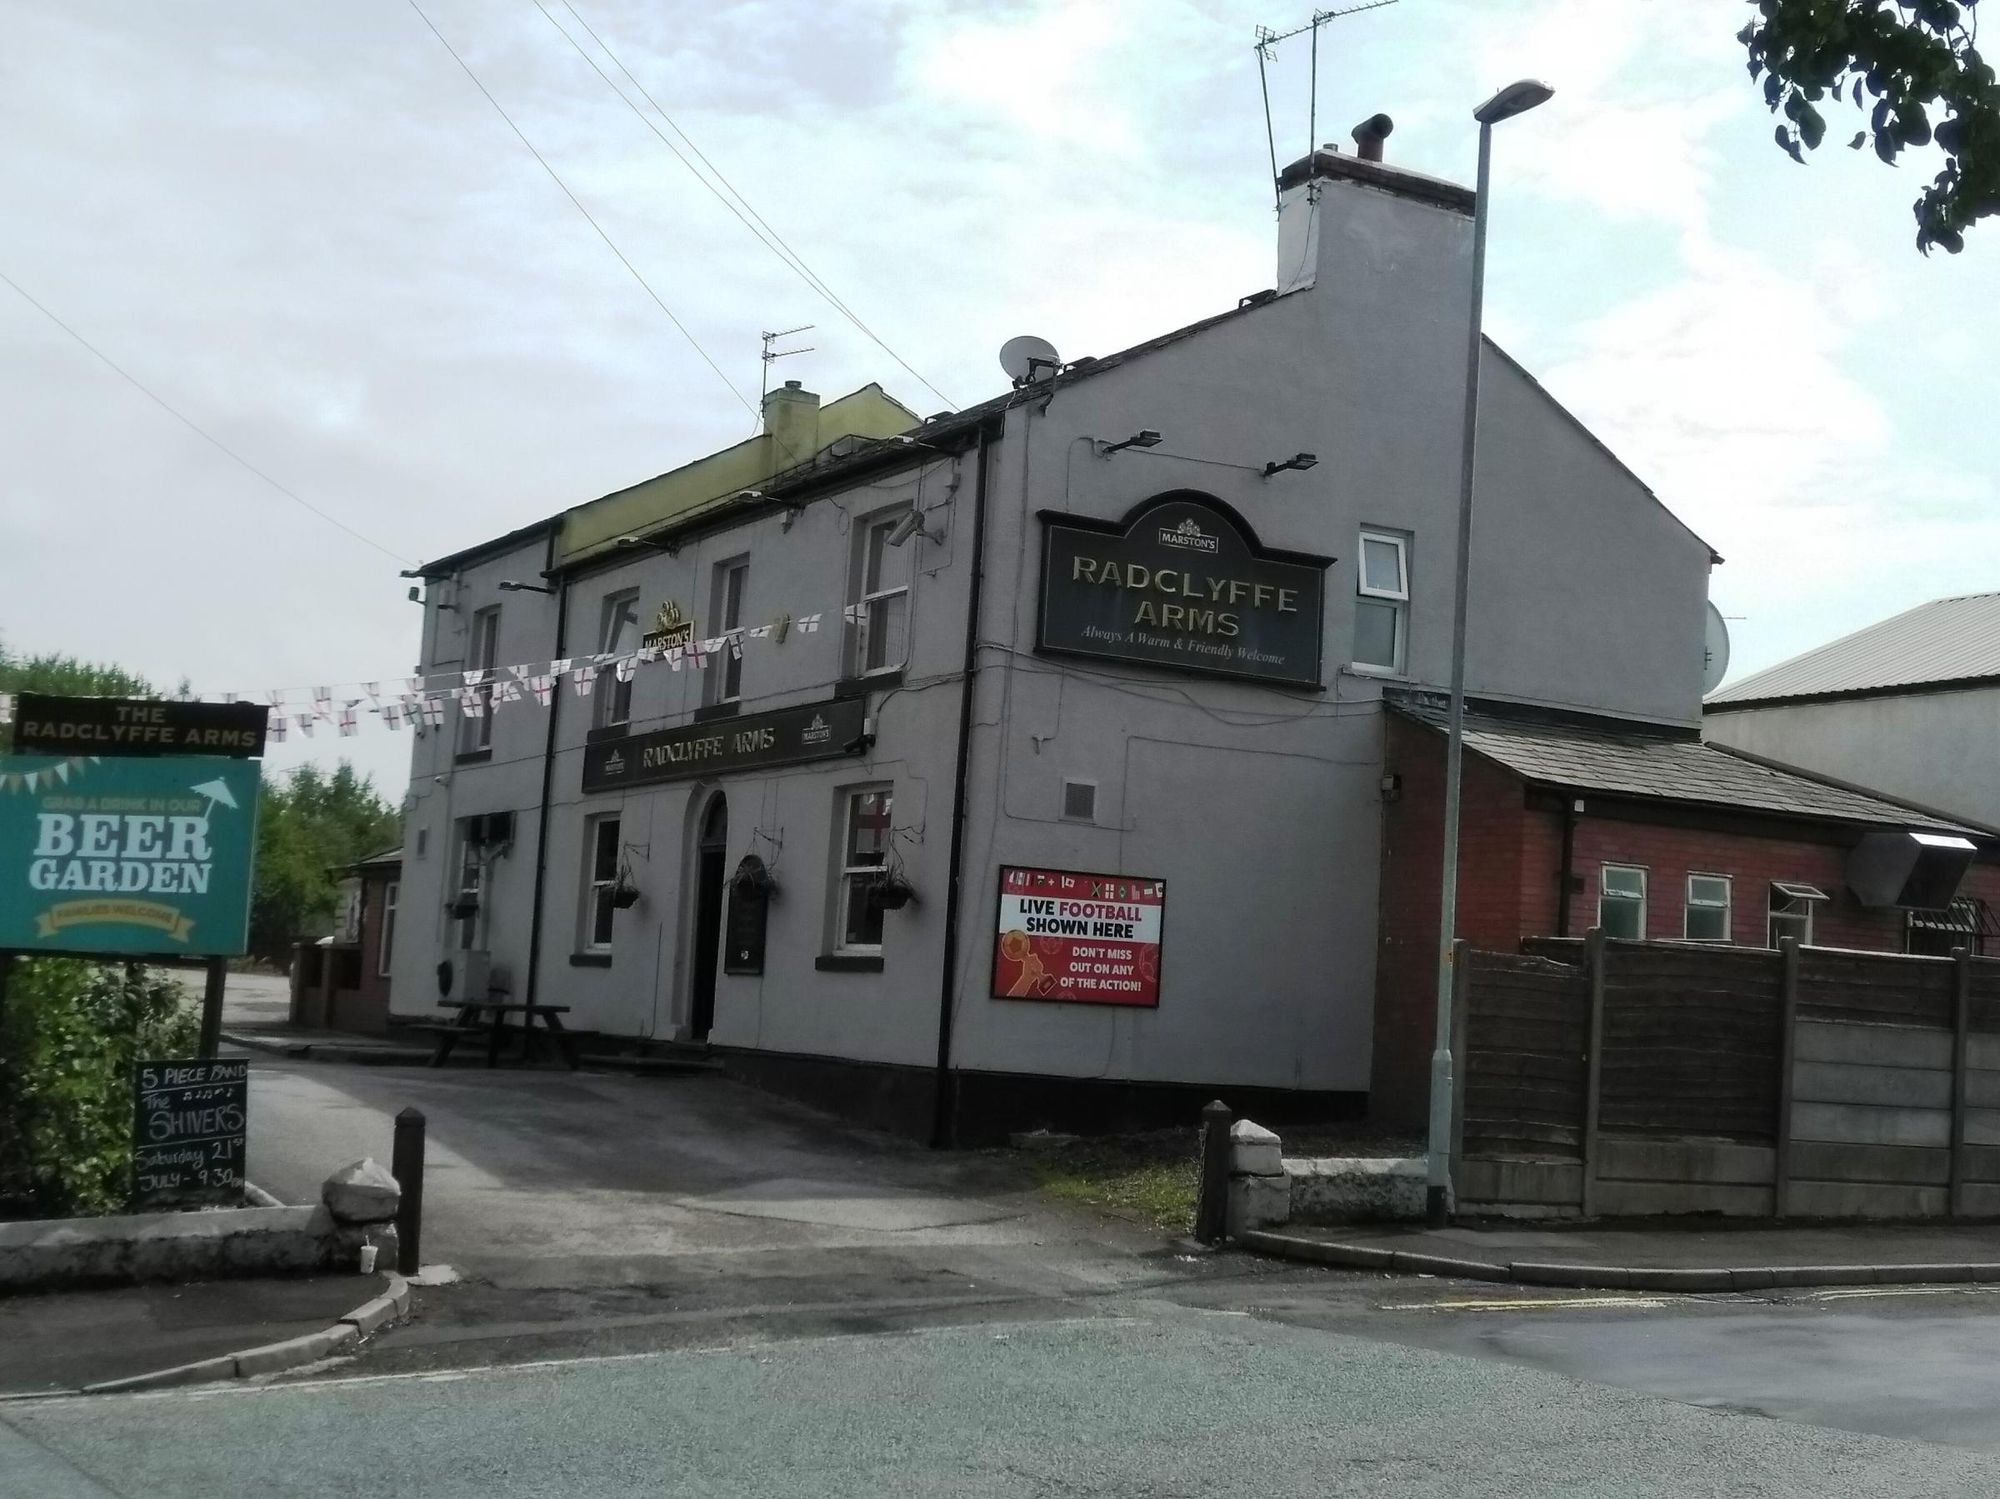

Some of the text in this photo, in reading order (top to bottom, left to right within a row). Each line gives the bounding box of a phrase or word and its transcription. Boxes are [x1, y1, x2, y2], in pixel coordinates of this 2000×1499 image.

[1161, 533, 1216, 550] MARSTON'S
[1072, 555, 1299, 612] RADCLYFFE
[1133, 601, 1240, 636] ARMS
[645, 630, 690, 650] MARSTON'S
[1081, 625, 1286, 665] Always A Warm & Friendly Welcome
[116, 706, 166, 723] THE
[23, 721, 257, 747] RADCLYFFE ARMS
[643, 728, 775, 768] RADCLYFFE ARMS
[33, 813, 213, 861] BEER
[29, 859, 213, 894] GARDEN
[1019, 899, 1142, 922] LIVE FOOTBALL
[1026, 917, 1134, 939] SHOWN HERE
[1072, 946, 1132, 960] DON'T MISS
[1070, 962, 1135, 976] OUT ON ANY
[1060, 977, 1142, 992] OF THE ACTION!
[142, 1065, 247, 1088] 5 PIECE BAND
[142, 1093, 170, 1109] The
[149, 1104, 245, 1140] SHIVERS
[135, 1149, 204, 1171] Saturday
[138, 1173, 180, 1191] JULY
